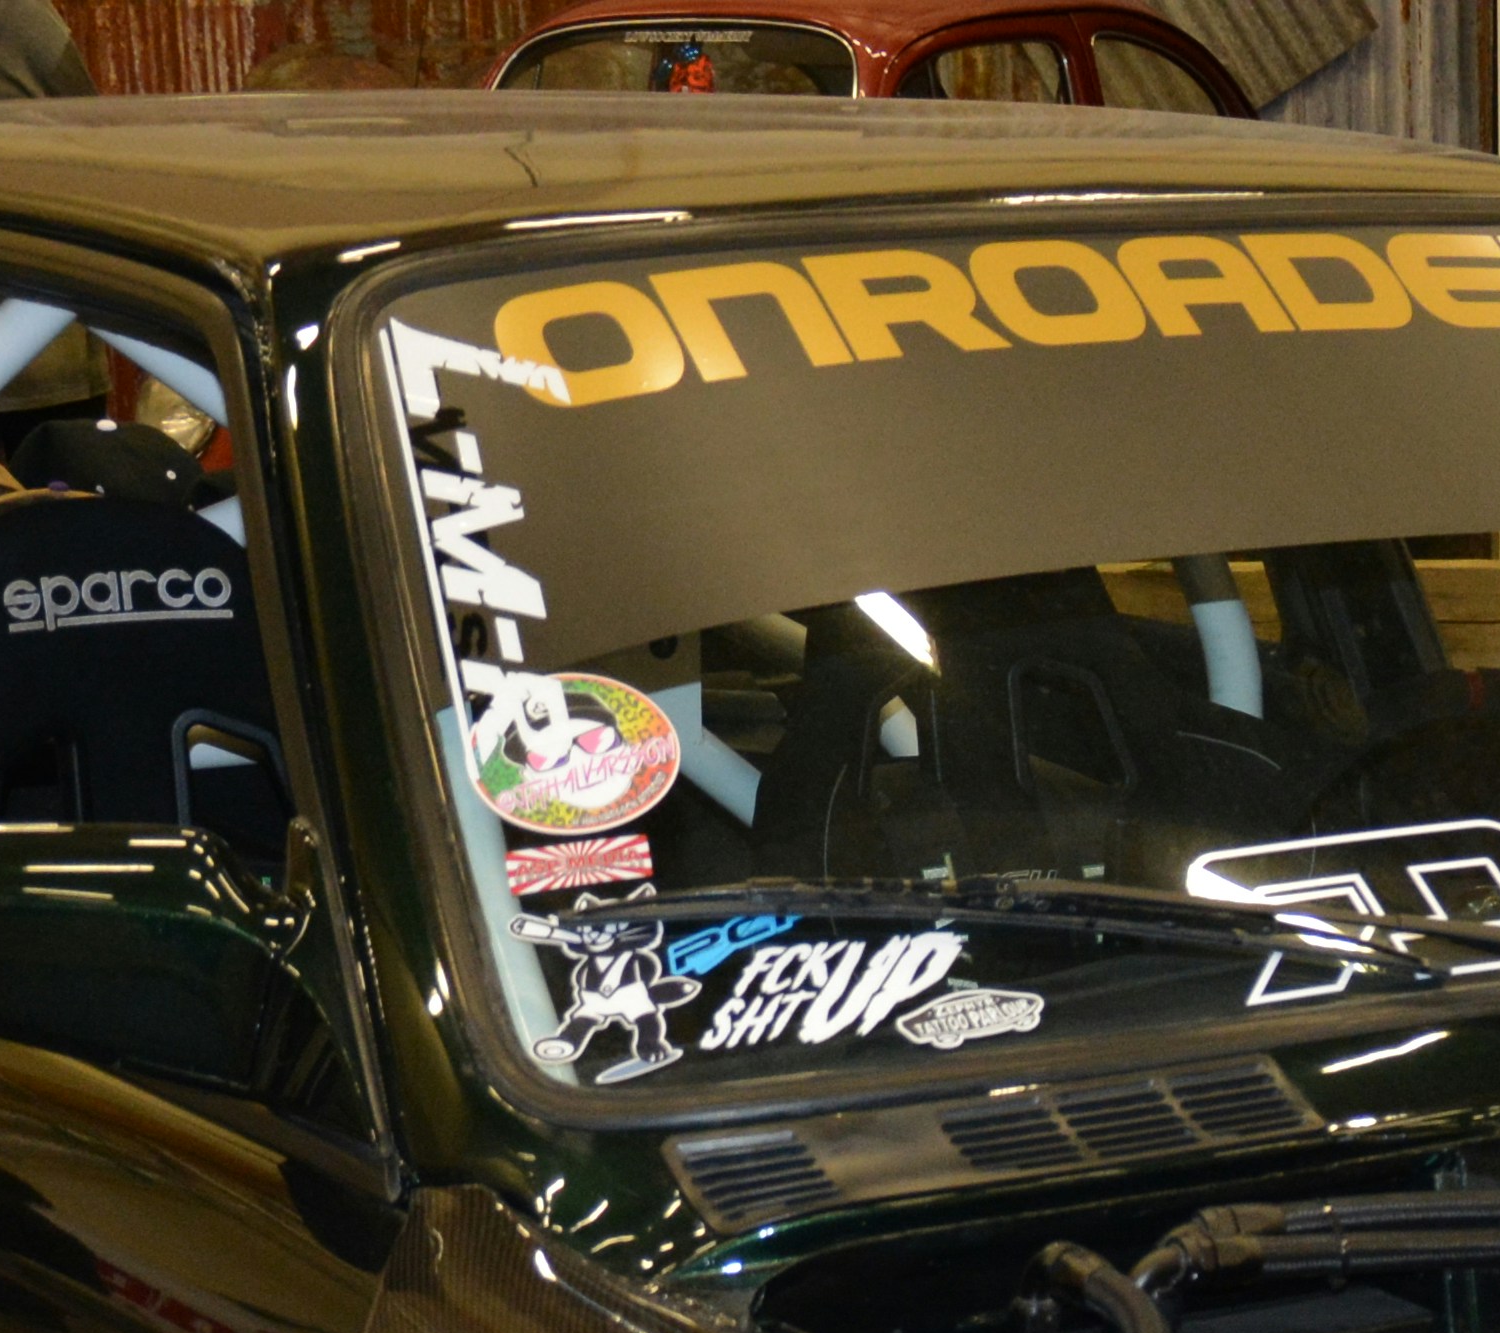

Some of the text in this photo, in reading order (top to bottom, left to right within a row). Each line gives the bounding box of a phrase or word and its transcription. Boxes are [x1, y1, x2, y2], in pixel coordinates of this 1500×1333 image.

[3, 567, 233, 632] sparco
[700, 988, 818, 1051] SHT
[734, 930, 964, 1045] FCK UP
